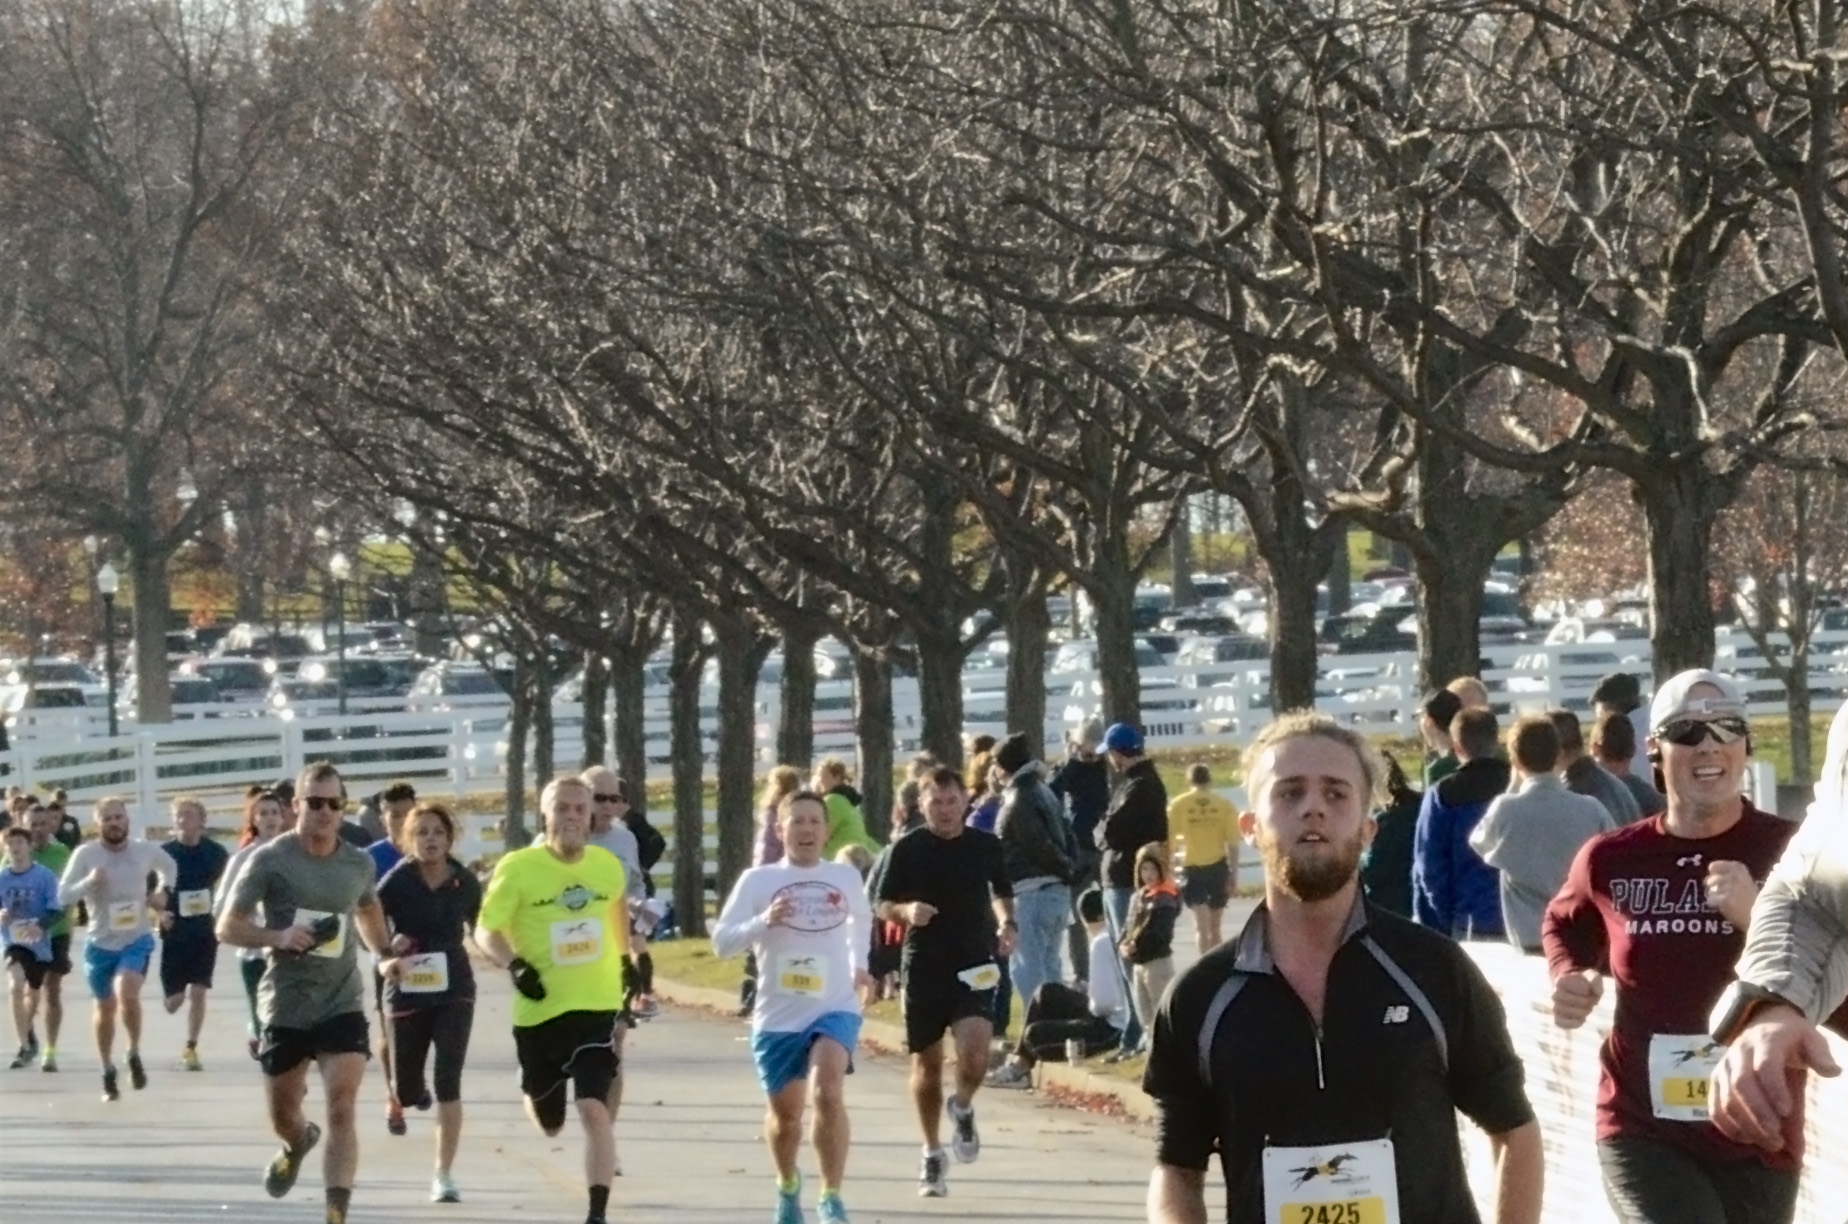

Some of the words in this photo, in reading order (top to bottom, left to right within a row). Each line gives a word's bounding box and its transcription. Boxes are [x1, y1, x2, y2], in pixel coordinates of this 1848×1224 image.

[1609, 879, 1766, 914] PULA
[1625, 919, 1734, 935] MAROONS
[1686, 1080, 1708, 1098] 14
